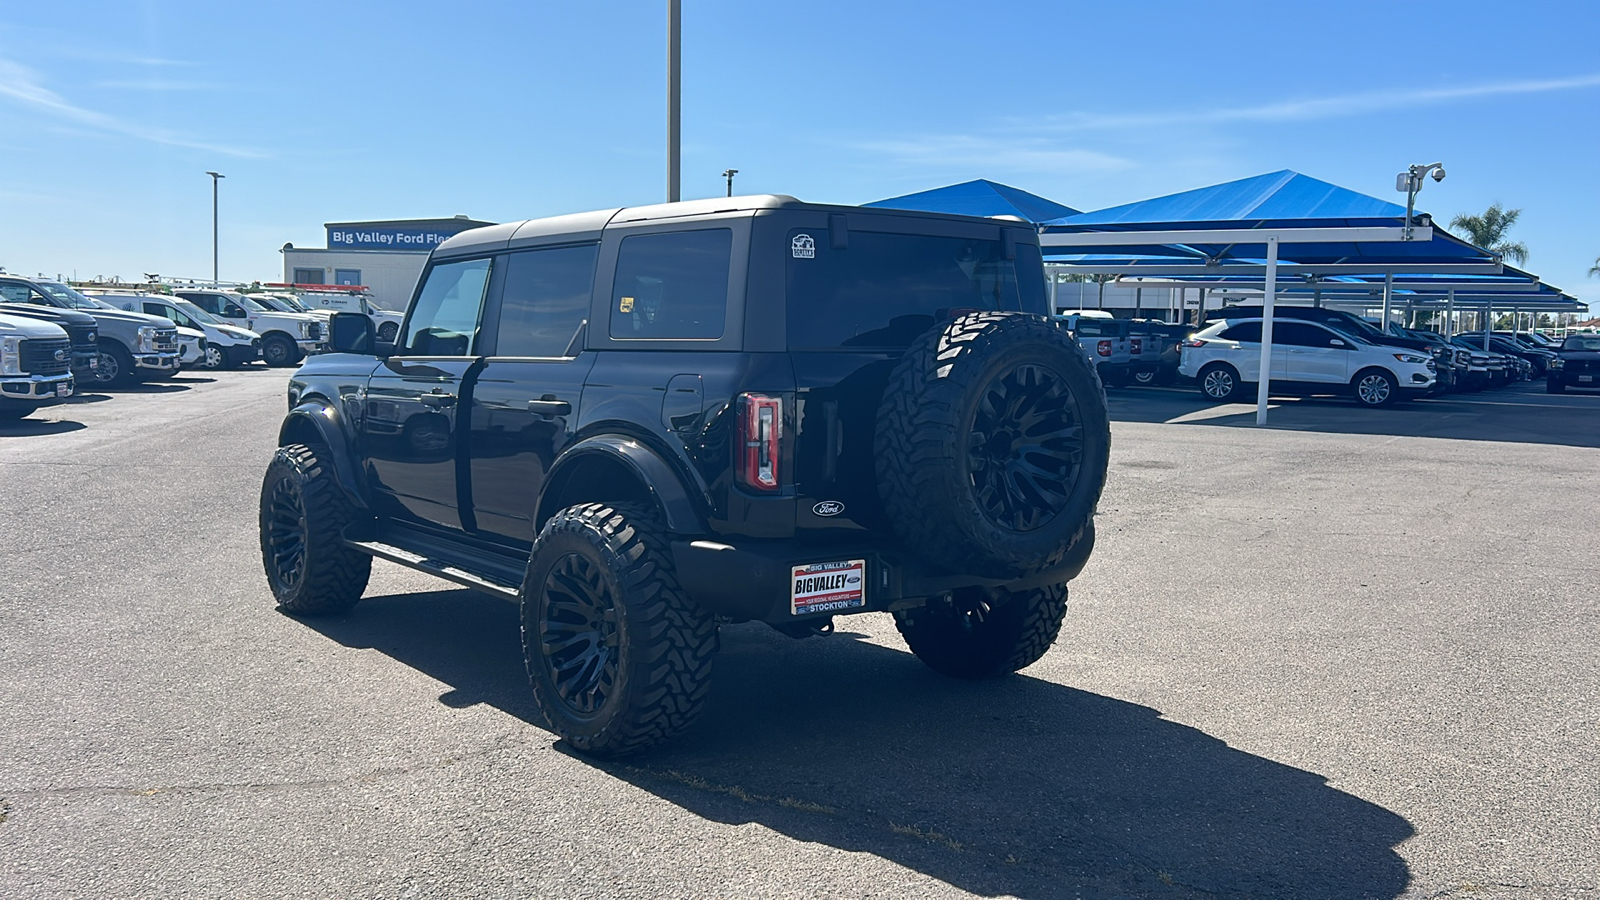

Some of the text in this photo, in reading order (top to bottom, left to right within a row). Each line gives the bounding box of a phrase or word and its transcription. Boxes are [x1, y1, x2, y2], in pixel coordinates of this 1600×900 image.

[333, 231, 354, 244] Big
[355, 231, 394, 245] Valley
[396, 232, 424, 244] Ford
[819, 503, 839, 514] Ford
[810, 562, 848, 572] BIG VALLEY
[810, 601, 848, 612] STOCKTON
